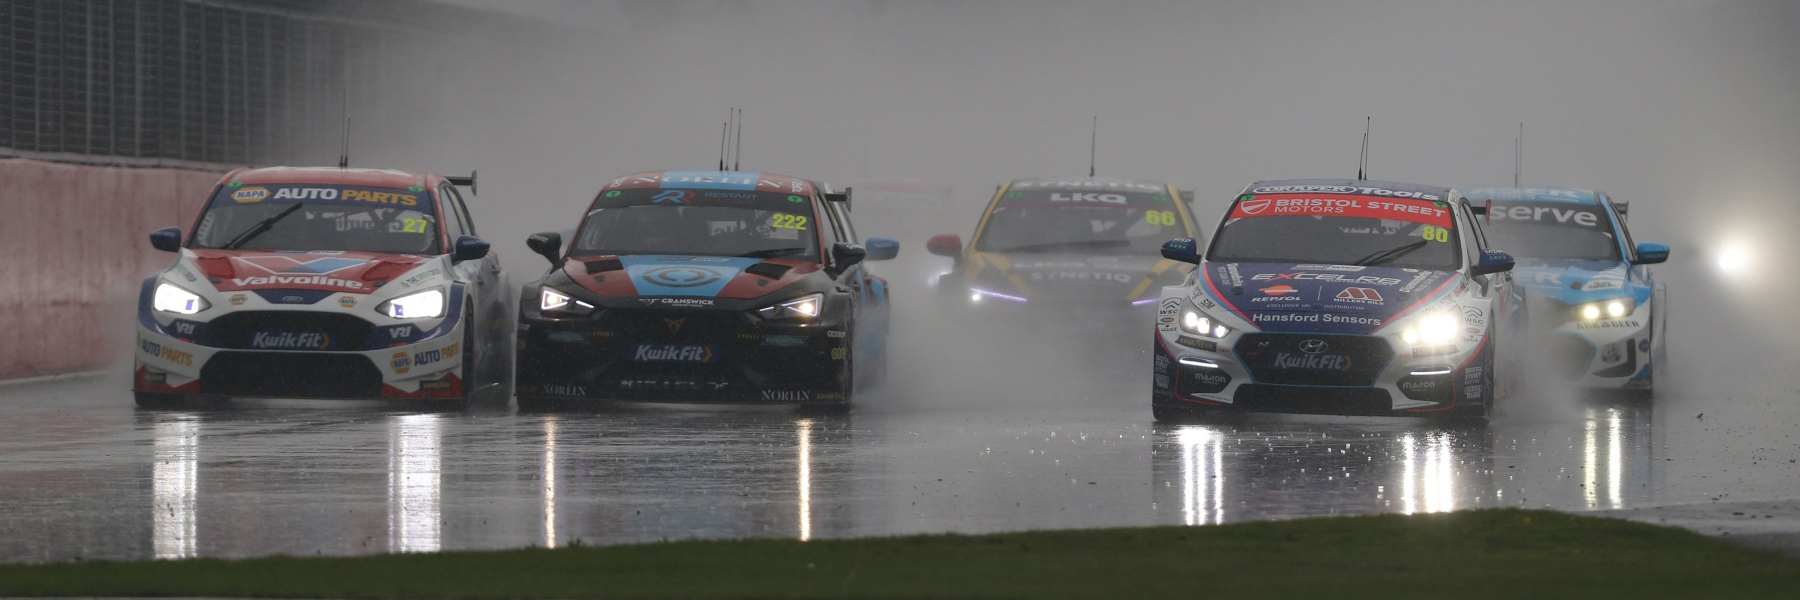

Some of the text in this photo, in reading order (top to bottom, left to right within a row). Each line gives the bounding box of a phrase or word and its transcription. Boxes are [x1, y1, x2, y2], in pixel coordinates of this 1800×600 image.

[237, 187, 417, 206] NAPA AUTO PARTS
[704, 191, 759, 200] RESTART
[1050, 192, 1127, 204] LKQ
[1358, 186, 1440, 201] Tools
[1276, 198, 1445, 217] BRISTOL STREET
[772, 213, 807, 230] 222
[1145, 209, 1176, 226] 66
[403, 218, 427, 233] 27
[1422, 226, 1449, 243] 80
[232, 275, 363, 289] Valvoline
[1030, 271, 1131, 283] SYNETIQ
[1251, 271, 1402, 284] EXCELR8
[1252, 313, 1381, 326] Hansford Sensors
[1464, 317, 1484, 325] WSC
[1611, 320, 1641, 328] BEER
[142, 339, 193, 366] AUTO PARTS
[414, 349, 441, 366] AUTO
[1465, 372, 1481, 380] STREET
[761, 389, 810, 401] NORLIN
